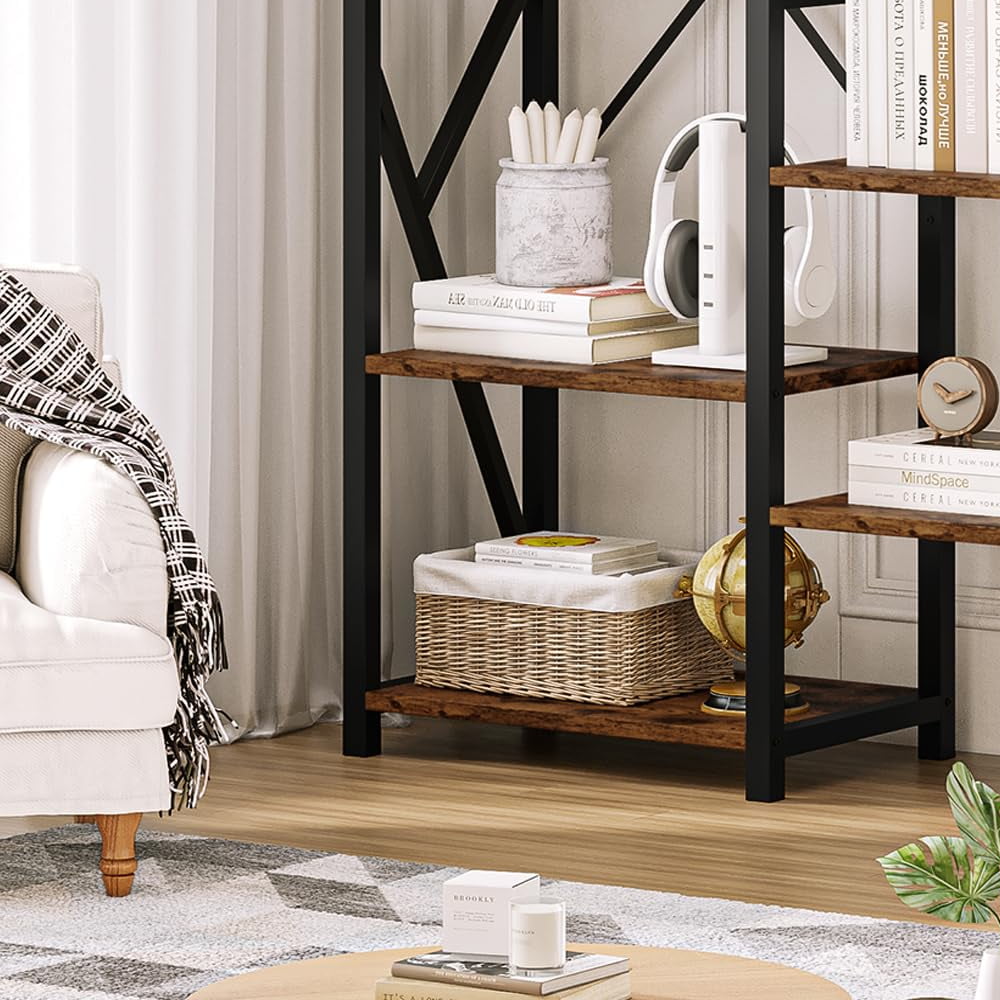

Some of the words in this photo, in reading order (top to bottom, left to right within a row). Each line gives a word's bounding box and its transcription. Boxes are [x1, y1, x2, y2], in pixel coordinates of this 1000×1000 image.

[894, 37, 905, 47] О
[894, 50, 906, 141] ПРЕДАННЫХ
[918, 74, 928, 146] ШОКОЛАД
[937, 102, 950, 149] ЛУЧШЕ
[903, 452, 952, 465] CEREAL
[979, 459, 1000, 468] YORK
[901, 471, 969, 488] MindSpace
[903, 491, 952, 505] CEREAL
[979, 499, 1000, 508] YORK
